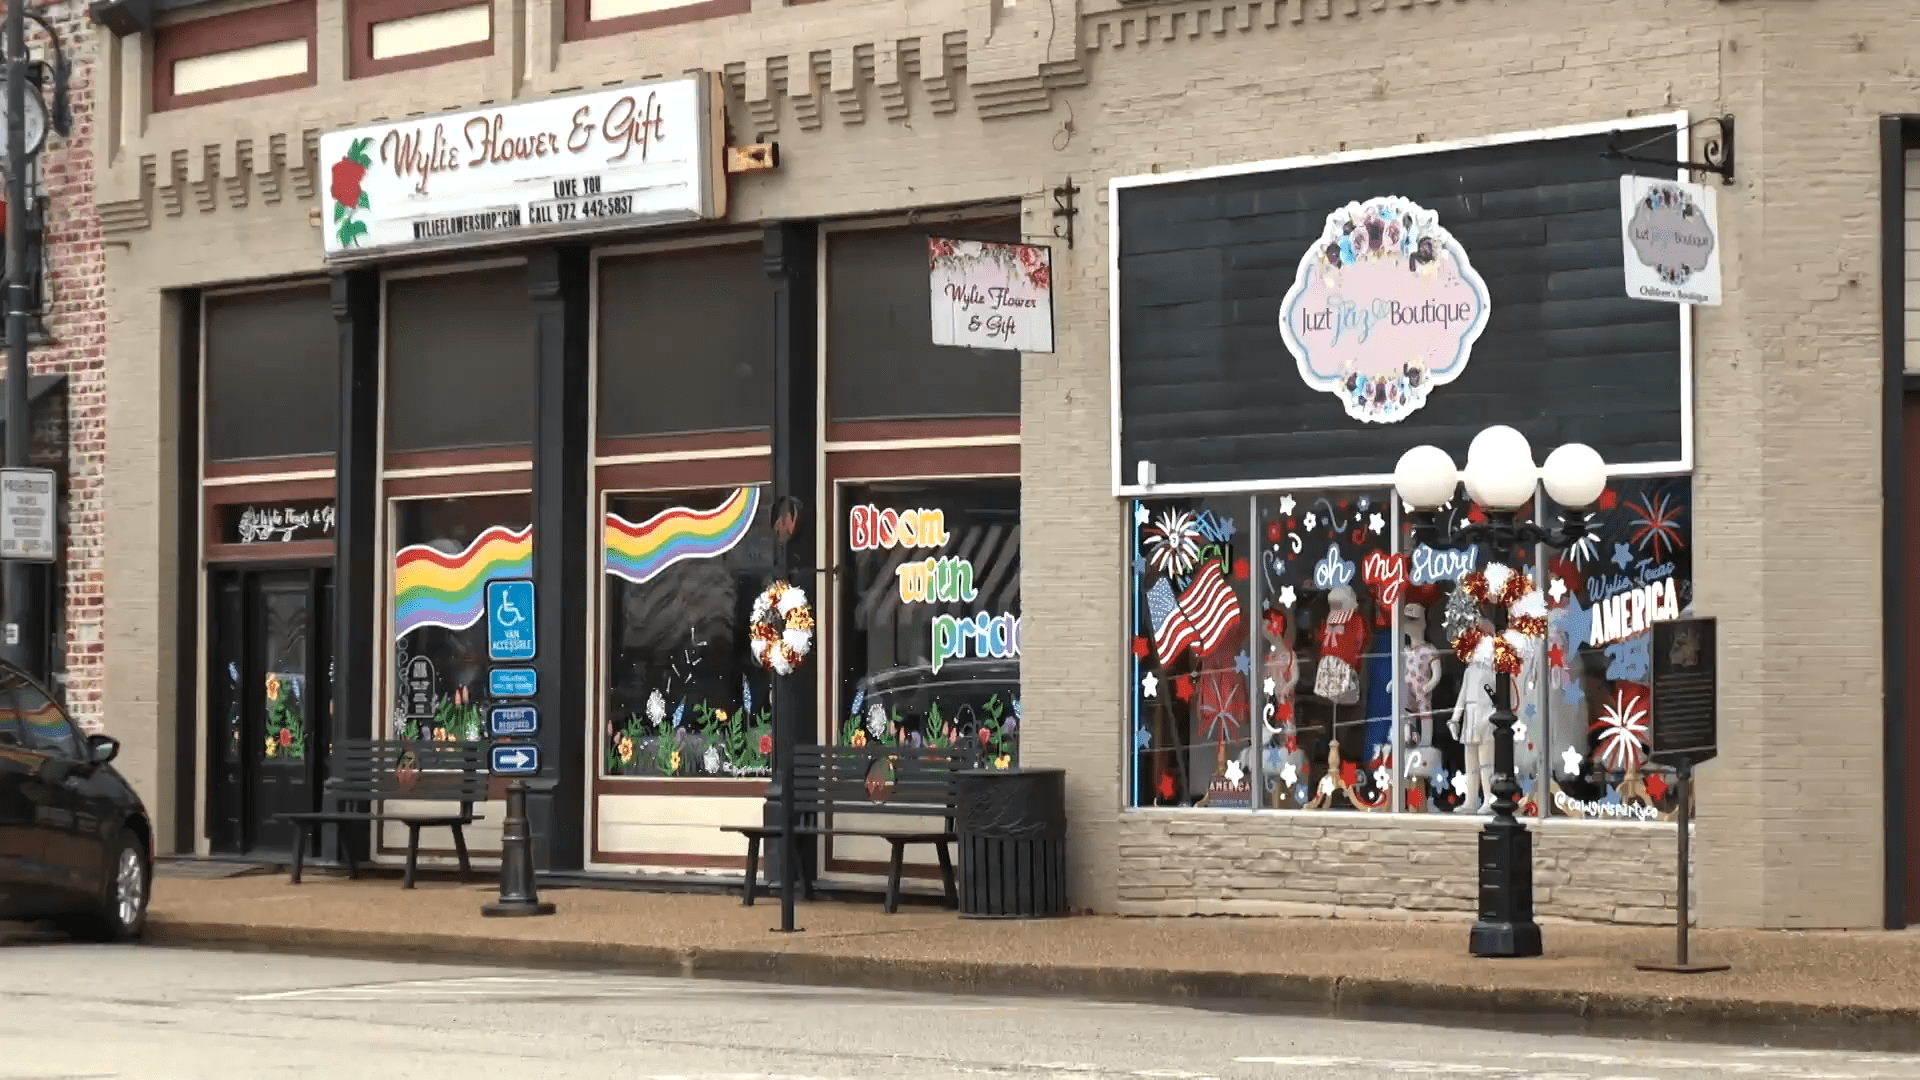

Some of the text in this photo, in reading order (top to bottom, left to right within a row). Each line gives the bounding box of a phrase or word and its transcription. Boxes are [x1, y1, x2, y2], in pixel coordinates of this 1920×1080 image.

[380, 90, 665, 196] Wylie Flower & Gift
[554, 176, 601, 198] LOVE YOU
[529, 206, 552, 225] CALL
[557, 203, 576, 222] 972
[582, 195, 633, 218] 442-5837
[944, 282, 1036, 312] Wylie Flower
[968, 314, 1016, 342] & Gift
[1302, 307, 1333, 337] Juzt
[1391, 298, 1471, 330] Boutique
[850, 502, 950, 551] Bloom
[895, 556, 978, 604] with
[1315, 544, 1354, 588] oh
[1363, 551, 1404, 605] my
[1589, 576, 1679, 647] AMERICA
[493, 639, 532, 651] ACCESSIBLE
[504, 629, 520, 639] VAN
